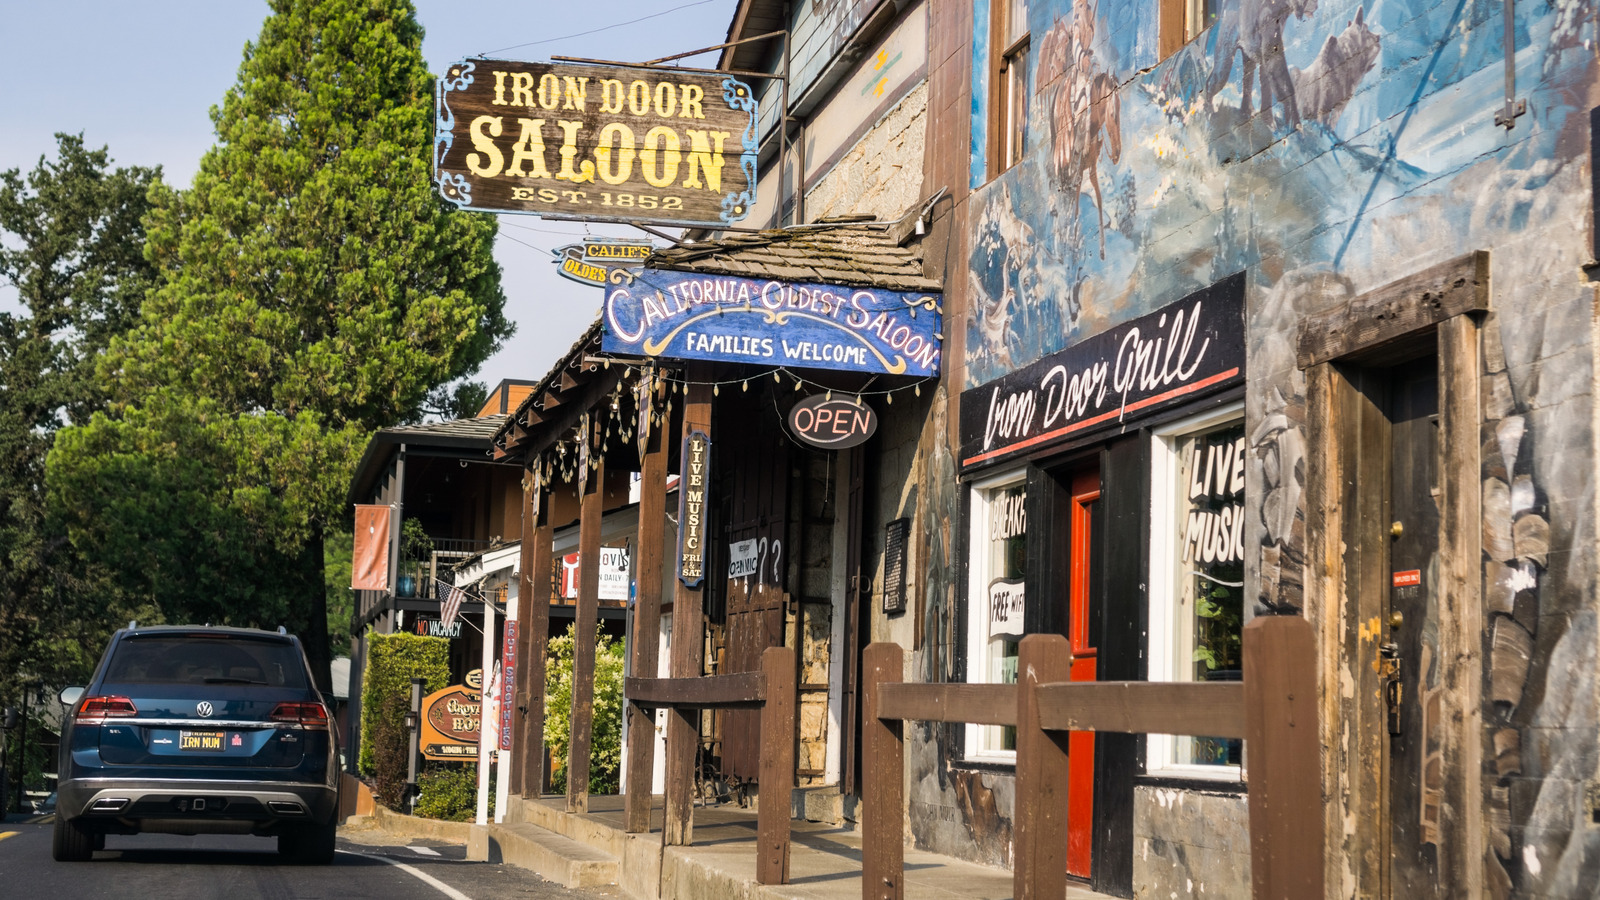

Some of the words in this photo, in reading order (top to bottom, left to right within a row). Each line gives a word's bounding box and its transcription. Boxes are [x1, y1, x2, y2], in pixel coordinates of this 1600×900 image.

[492, 71, 589, 112] IRON
[599, 79, 705, 119] DOOR
[466, 115, 730, 195] SALOON
[511, 187, 592, 204] EST.
[600, 193, 683, 210] 1852
[564, 259, 607, 282] OLDES
[587, 244, 650, 258] CALIF'S
[607, 280, 759, 343] CALIFORNIA'S
[761, 280, 847, 318] OLDEST
[847, 291, 939, 370] SALOON
[687, 332, 774, 357] FAMILIES
[782, 340, 867, 365] WELCOME
[983, 386, 1038, 451] Iron
[1041, 364, 1109, 429] Door
[1114, 301, 1210, 423] Grill
[795, 407, 871, 434] OPEN
[690, 440, 704, 486] LIVE
[1189, 437, 1245, 499] LIVE
[687, 490, 703, 549] MUSIC
[991, 492, 1027, 541] BREAKF
[1182, 503, 1245, 563] MUSIC
[604, 574, 621, 582] DAILY
[416, 619, 428, 637] NO
[991, 591, 1010, 622] FREE
[502, 666, 515, 747] SMOOTHIES
[183, 736, 201, 748] IRN
[202, 736, 221, 749] MUM
